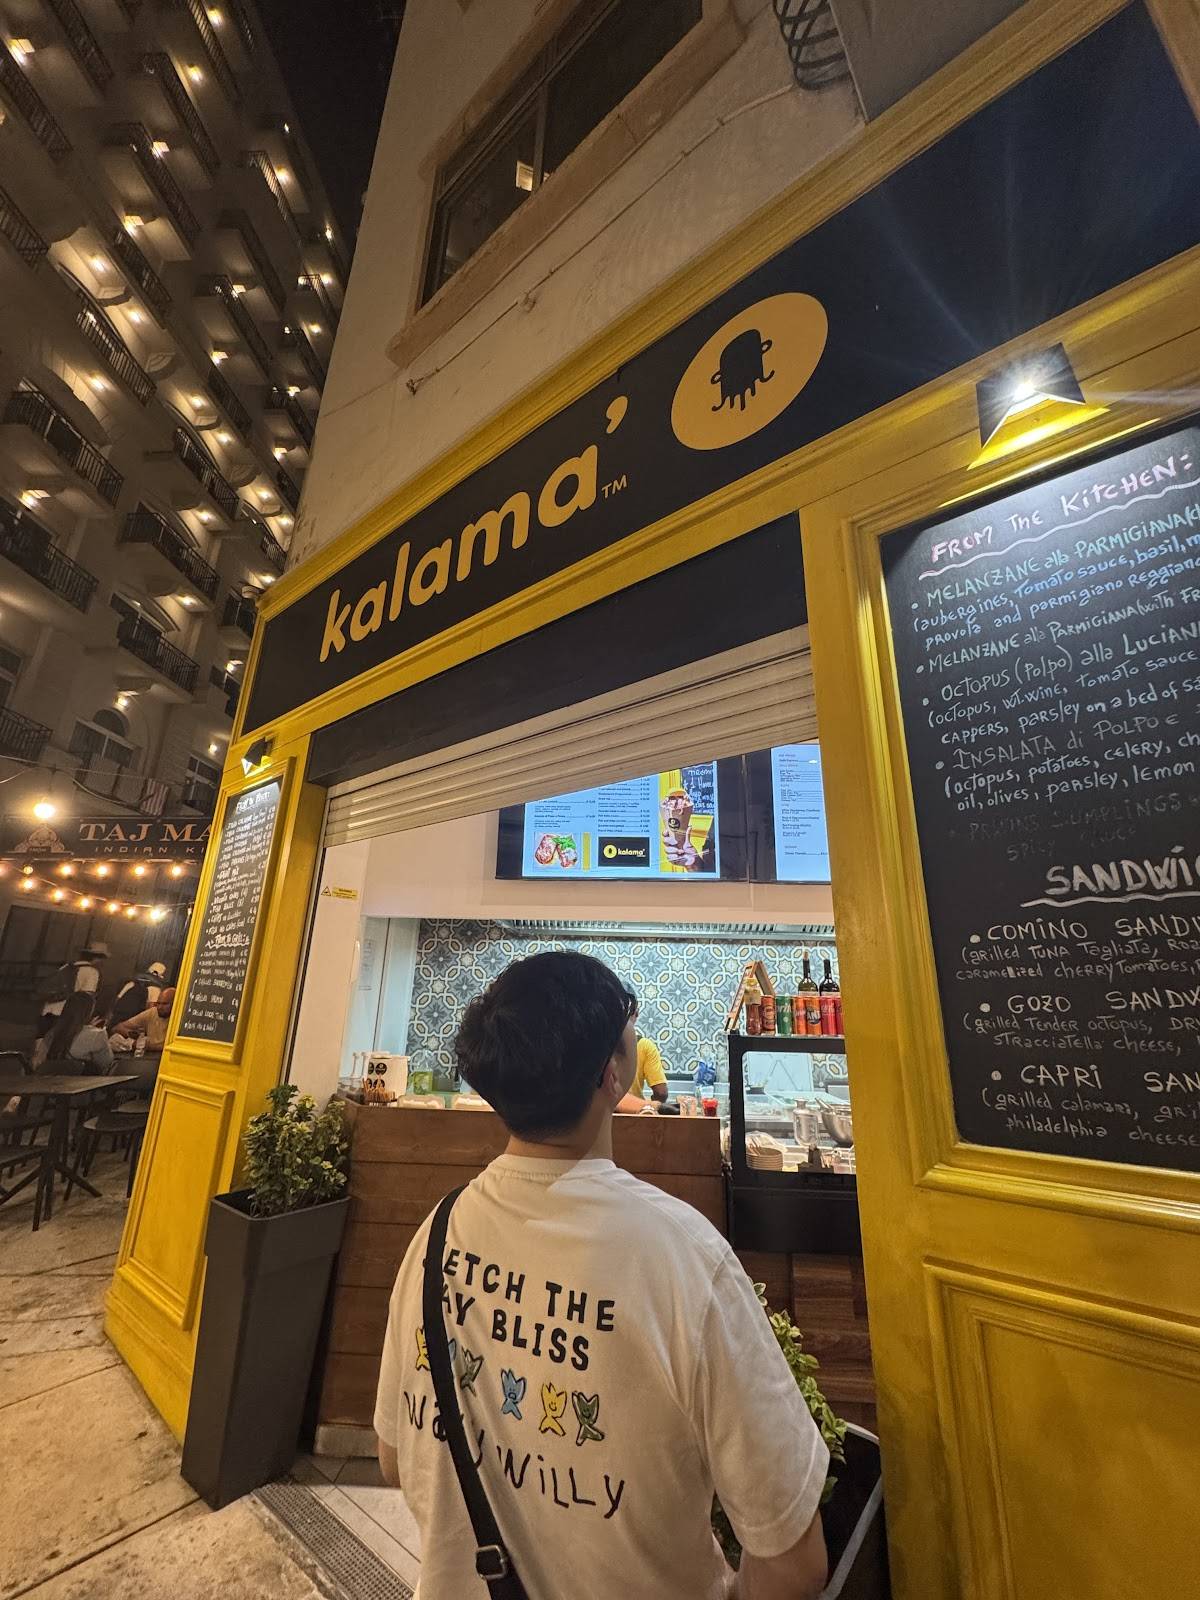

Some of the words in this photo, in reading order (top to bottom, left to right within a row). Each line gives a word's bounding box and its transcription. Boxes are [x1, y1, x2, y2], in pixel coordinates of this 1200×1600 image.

[601, 474, 628, 498] TM
[931, 526, 993, 563] FROM
[927, 557, 1041, 607] MELANZANE
[1044, 549, 1070, 569] alla
[994, 604, 1023, 628] and
[929, 633, 1020, 673] MELANZANE
[1023, 626, 1046, 645] alla
[941, 669, 1011, 701] OCTOPUS
[1081, 641, 1113, 666] alla
[1123, 620, 1200, 656] LUCIAN
[1086, 702, 1106, 713] on
[1110, 696, 1122, 708] a
[1127, 682, 1158, 707] bed
[1162, 681, 1178, 700] of
[953, 735, 1057, 769] INSALATA
[1067, 730, 1083, 749] di
[1093, 716, 1159, 740] POLPO
[1132, 761, 1195, 784] lemon
[79, 823, 153, 842] TAJ
[95, 846, 168, 854] INDIAN
[1044, 845, 1200, 895] SANDWI
[987, 917, 1088, 940] COMINO
[1027, 944, 1071, 959] TUNA
[1007, 994, 1072, 1014] GOZO
[423, 1242, 525, 1303] ETCH
[546, 1281, 615, 1331] THE
[441, 1283, 475, 1327] AY
[491, 1309, 589, 1371] BLISS
